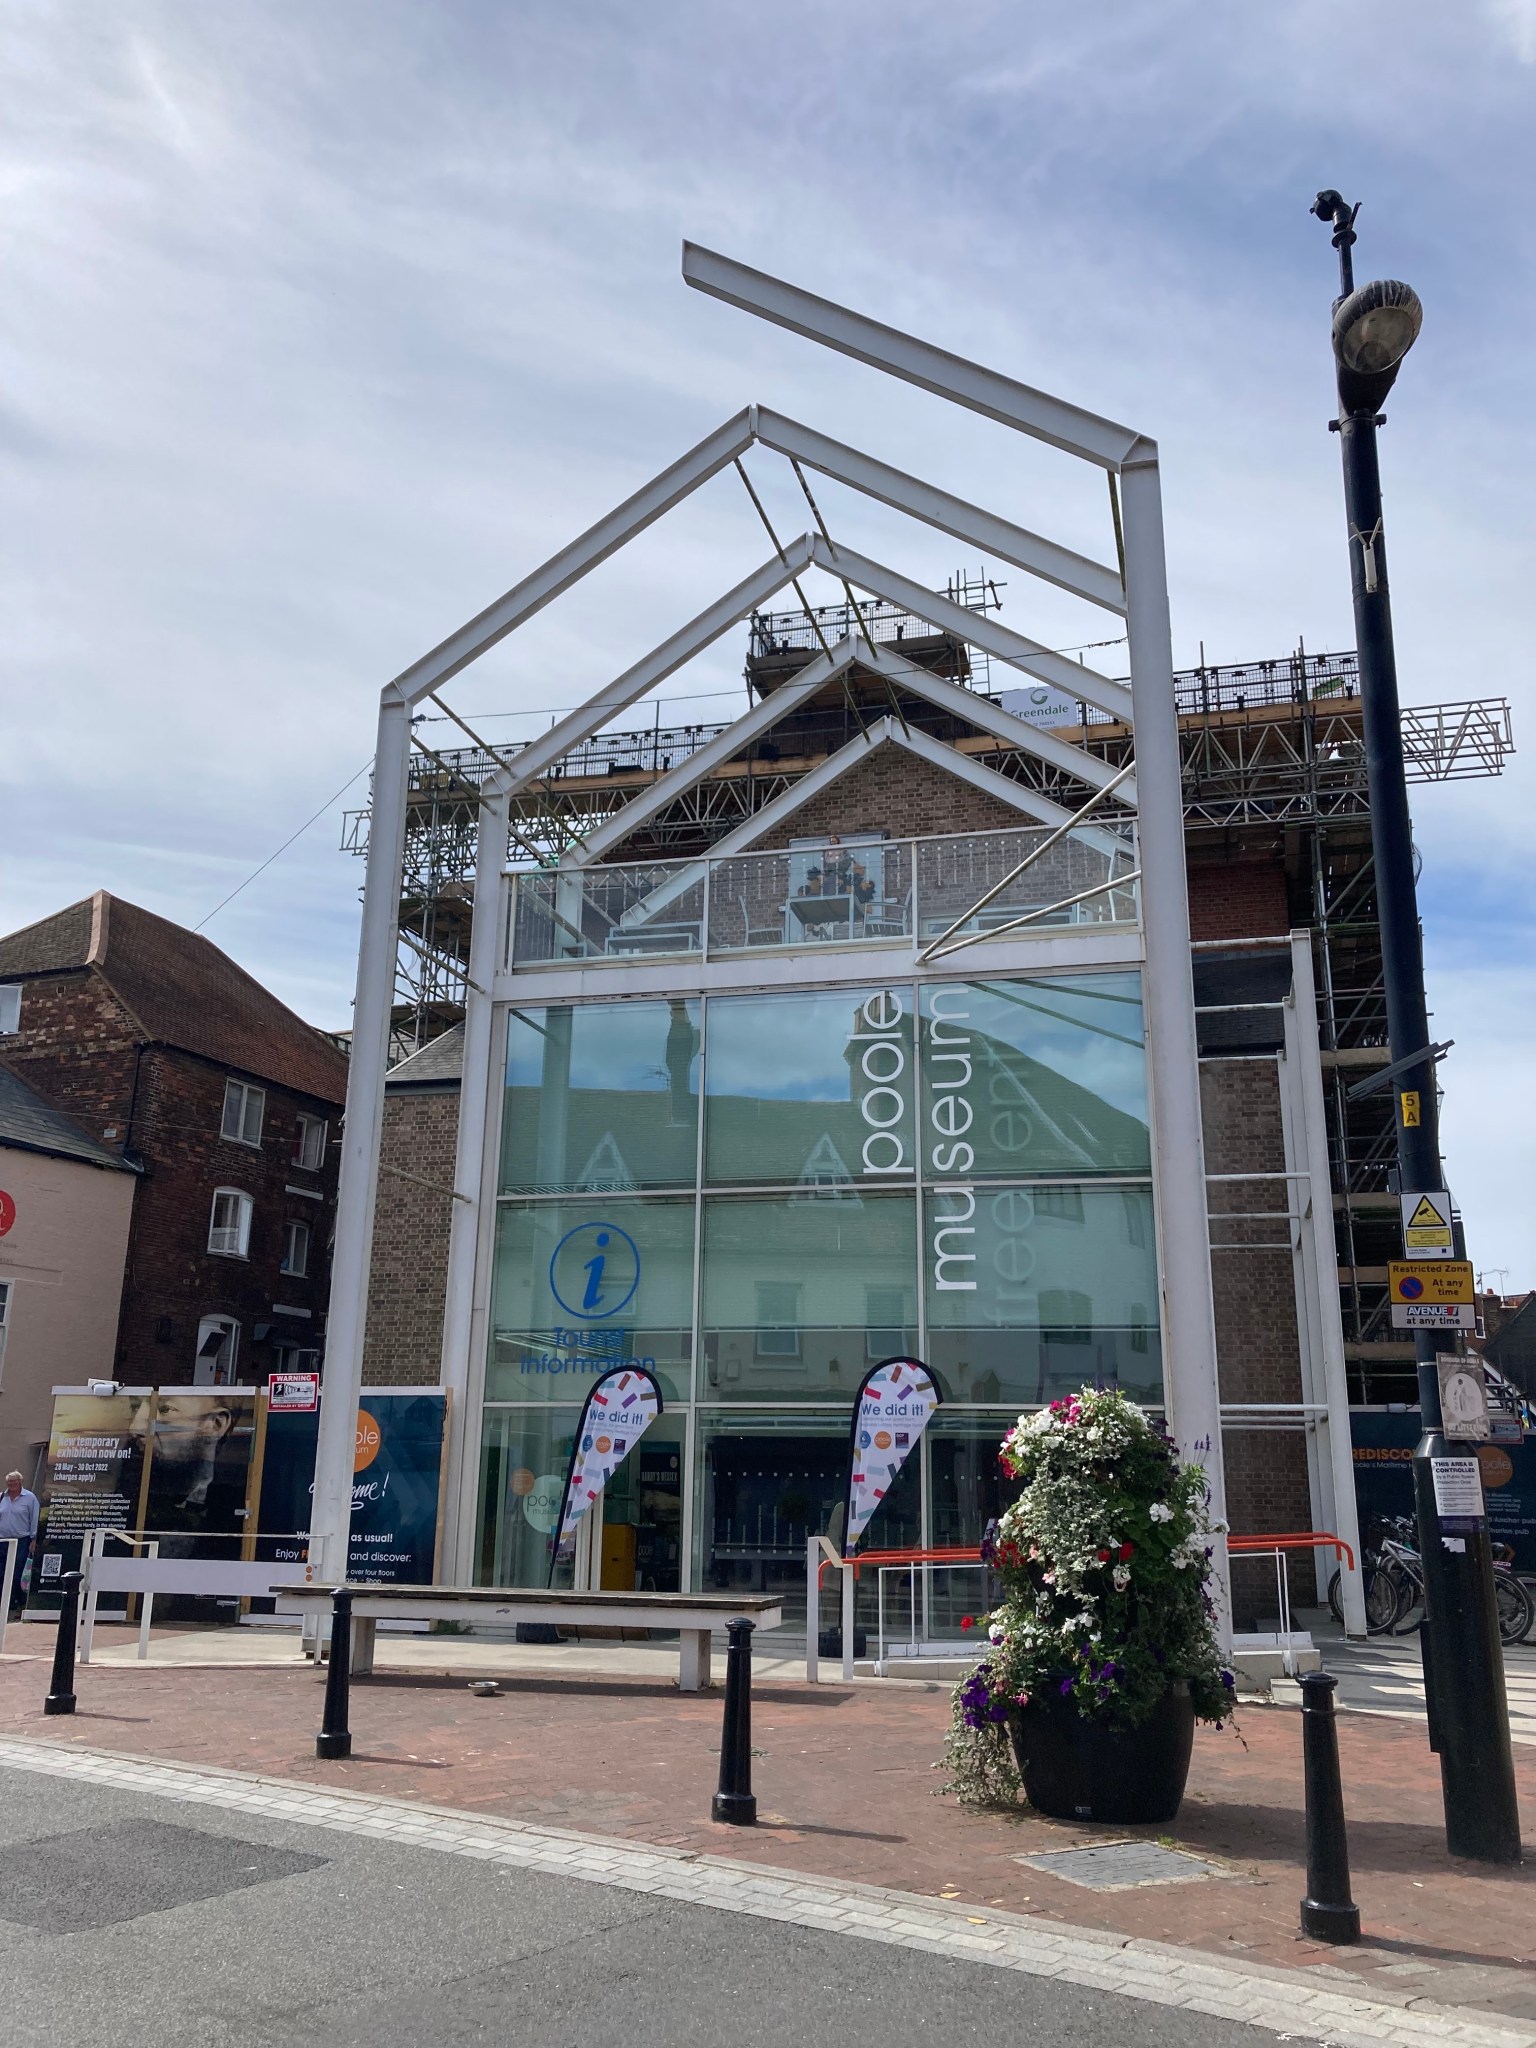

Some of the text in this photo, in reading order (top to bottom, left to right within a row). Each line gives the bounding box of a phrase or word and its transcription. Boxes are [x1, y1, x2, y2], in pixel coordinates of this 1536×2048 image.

[846, 990, 914, 1173] poole
[1406, 1095, 1415, 1106] 5
[1407, 1111, 1416, 1123] A
[930, 988, 977, 1291] museum
[1393, 1265, 1468, 1273] Restricted Zone
[1432, 1279, 1444, 1287] At
[1408, 1306, 1448, 1315] AVENUE
[554, 1327, 625, 1348] Tourist
[521, 1353, 656, 1374] Information
[861, 1404, 923, 1415] We did it!
[589, 1409, 643, 1425] We did it!
[58, 1437, 120, 1449] New temporary
[57, 1447, 132, 1459] exhibition now on!
[1353, 1448, 1416, 1460] REDISCO
[62, 1463, 74, 1472] May
[85, 1463, 95, 1471] Oct
[95, 1463, 108, 1471] 2022
[53, 1473, 96, 1482] (charges apply)
[365, 1533, 393, 1543] usual!
[276, 1549, 299, 1559] Enjoy
[350, 1552, 368, 1561] and
[371, 1552, 411, 1562] discover:
